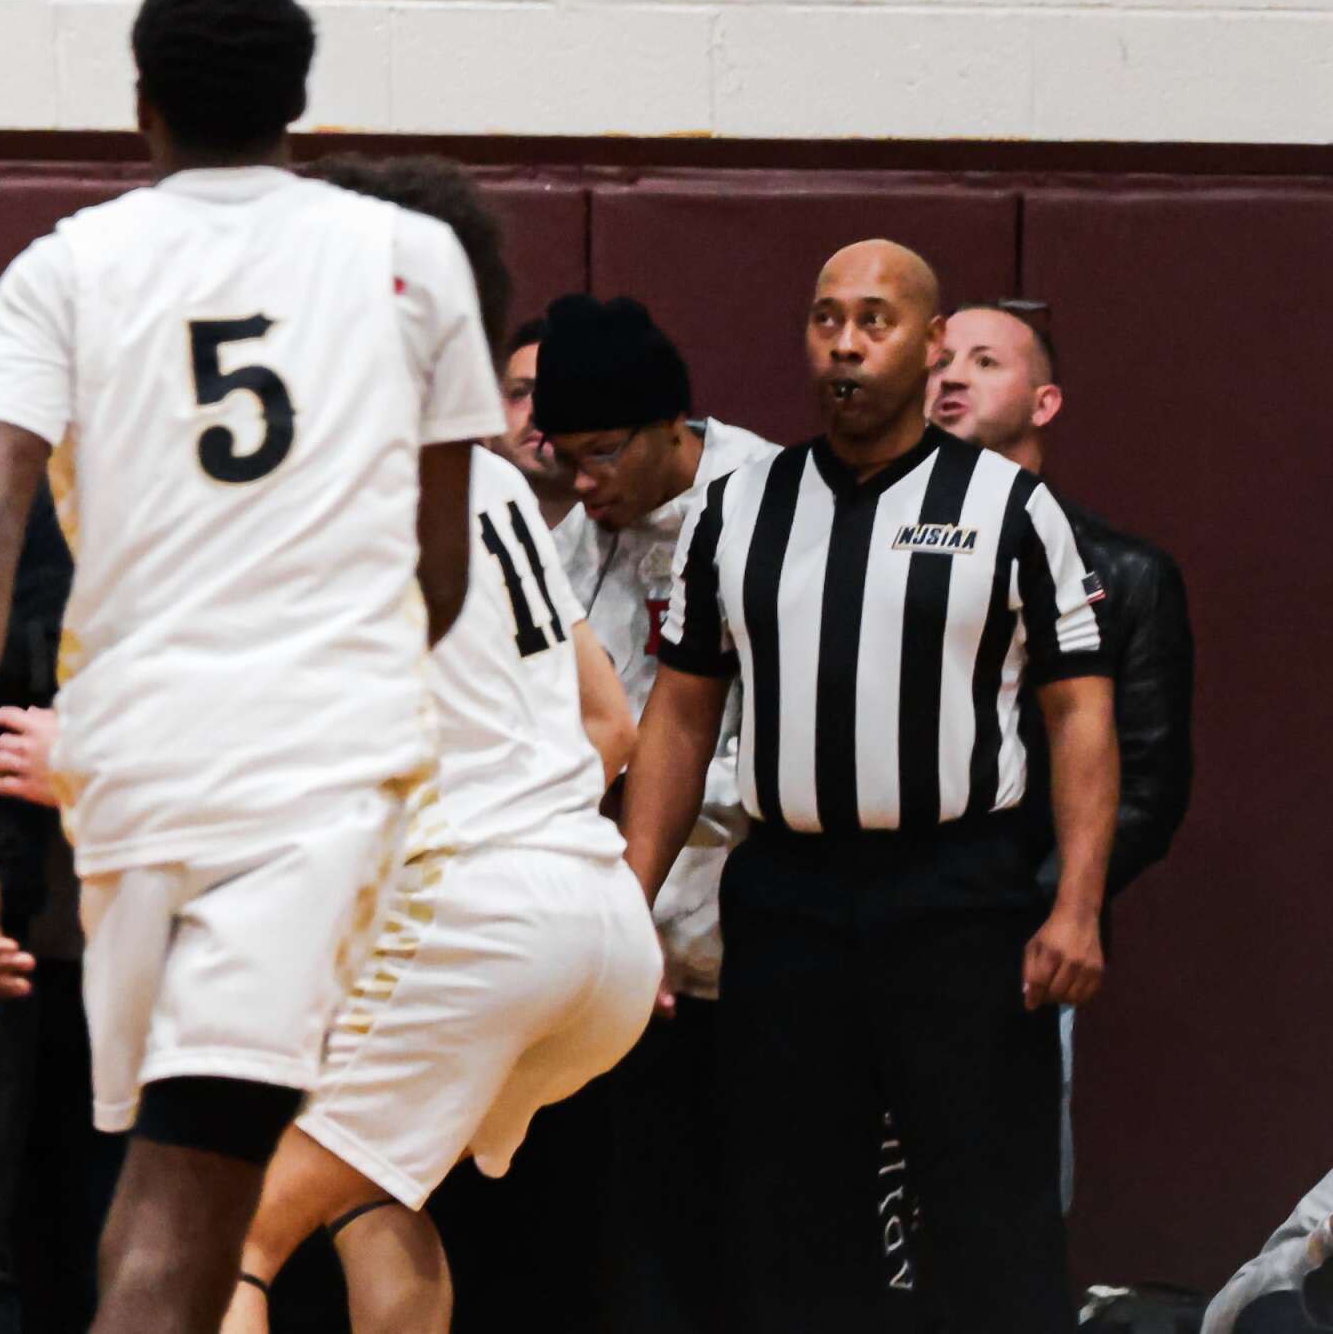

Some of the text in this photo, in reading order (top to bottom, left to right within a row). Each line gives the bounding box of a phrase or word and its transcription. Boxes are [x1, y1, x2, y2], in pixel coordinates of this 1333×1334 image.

[188, 313, 296, 484] 5
[478, 500, 566, 658] 11
[897, 525, 978, 549] NJSIAA
